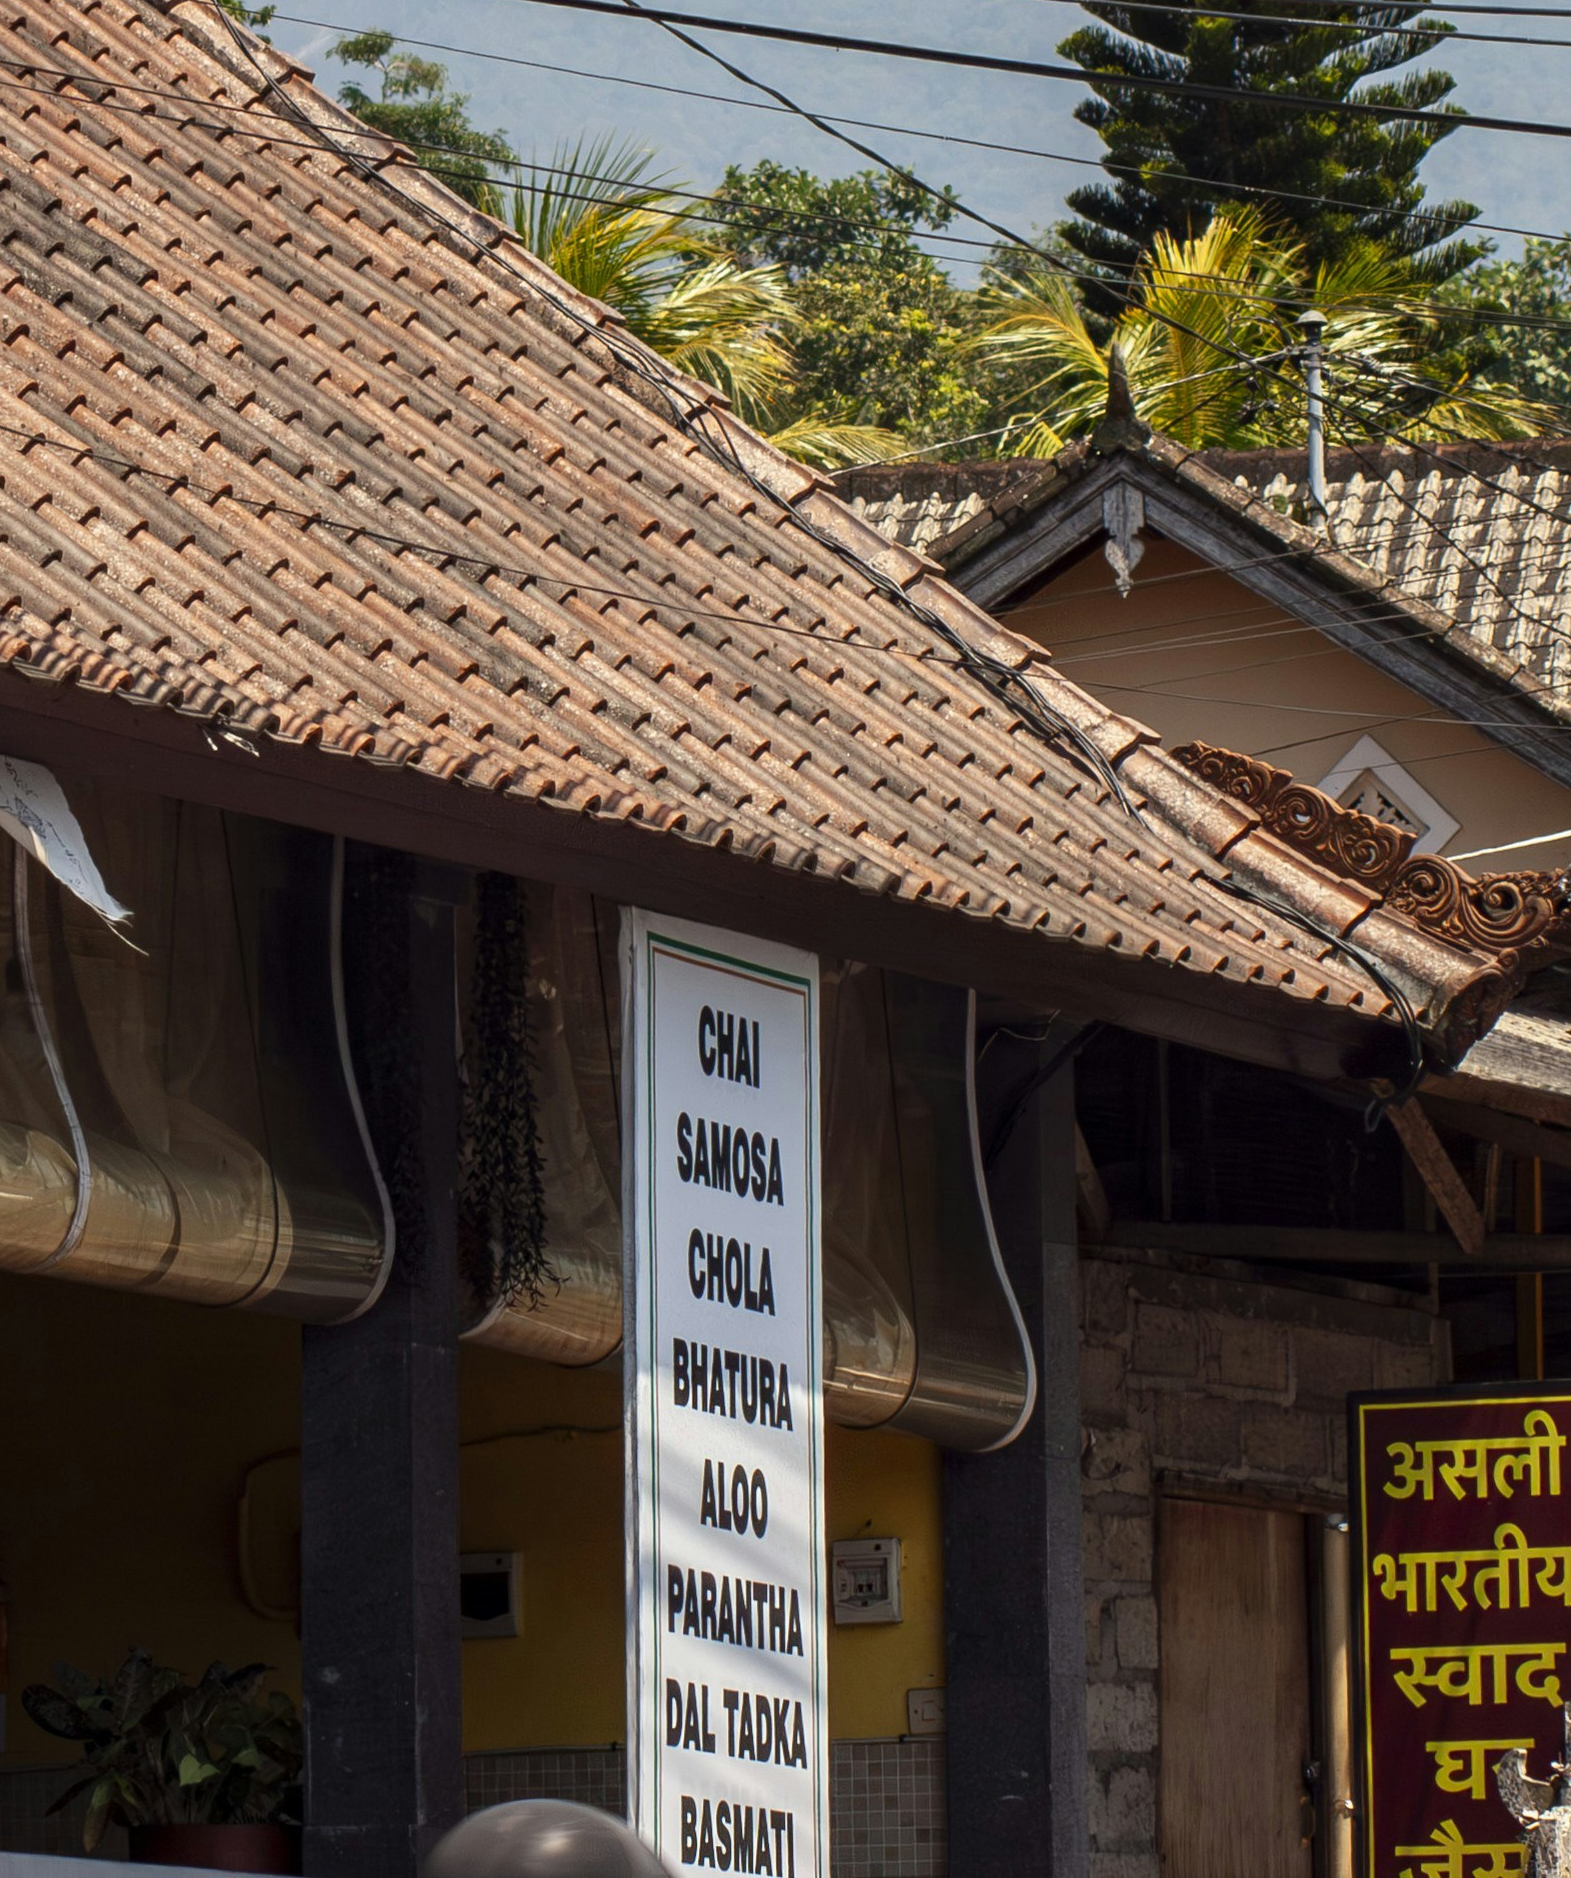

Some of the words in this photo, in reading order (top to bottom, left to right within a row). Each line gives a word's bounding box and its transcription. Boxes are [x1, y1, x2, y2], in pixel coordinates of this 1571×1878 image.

[698, 1005, 760, 1089] CHAI
[676, 1112, 784, 1206] SAMOSA
[688, 1228, 776, 1316] CHOLA
[673, 1338, 793, 1431] BHATURA
[700, 1459, 768, 1538] ALOO
[1382, 1409, 1567, 1501] असली
[667, 1564, 804, 1657] PARANTHA
[1389, 1642, 1567, 1708] स्वाद
[666, 1678, 716, 1754] DAL
[723, 1689, 808, 1769] TADKA
[1425, 1738, 1535, 1800] घ
[681, 1796, 795, 1878] BASMATI
